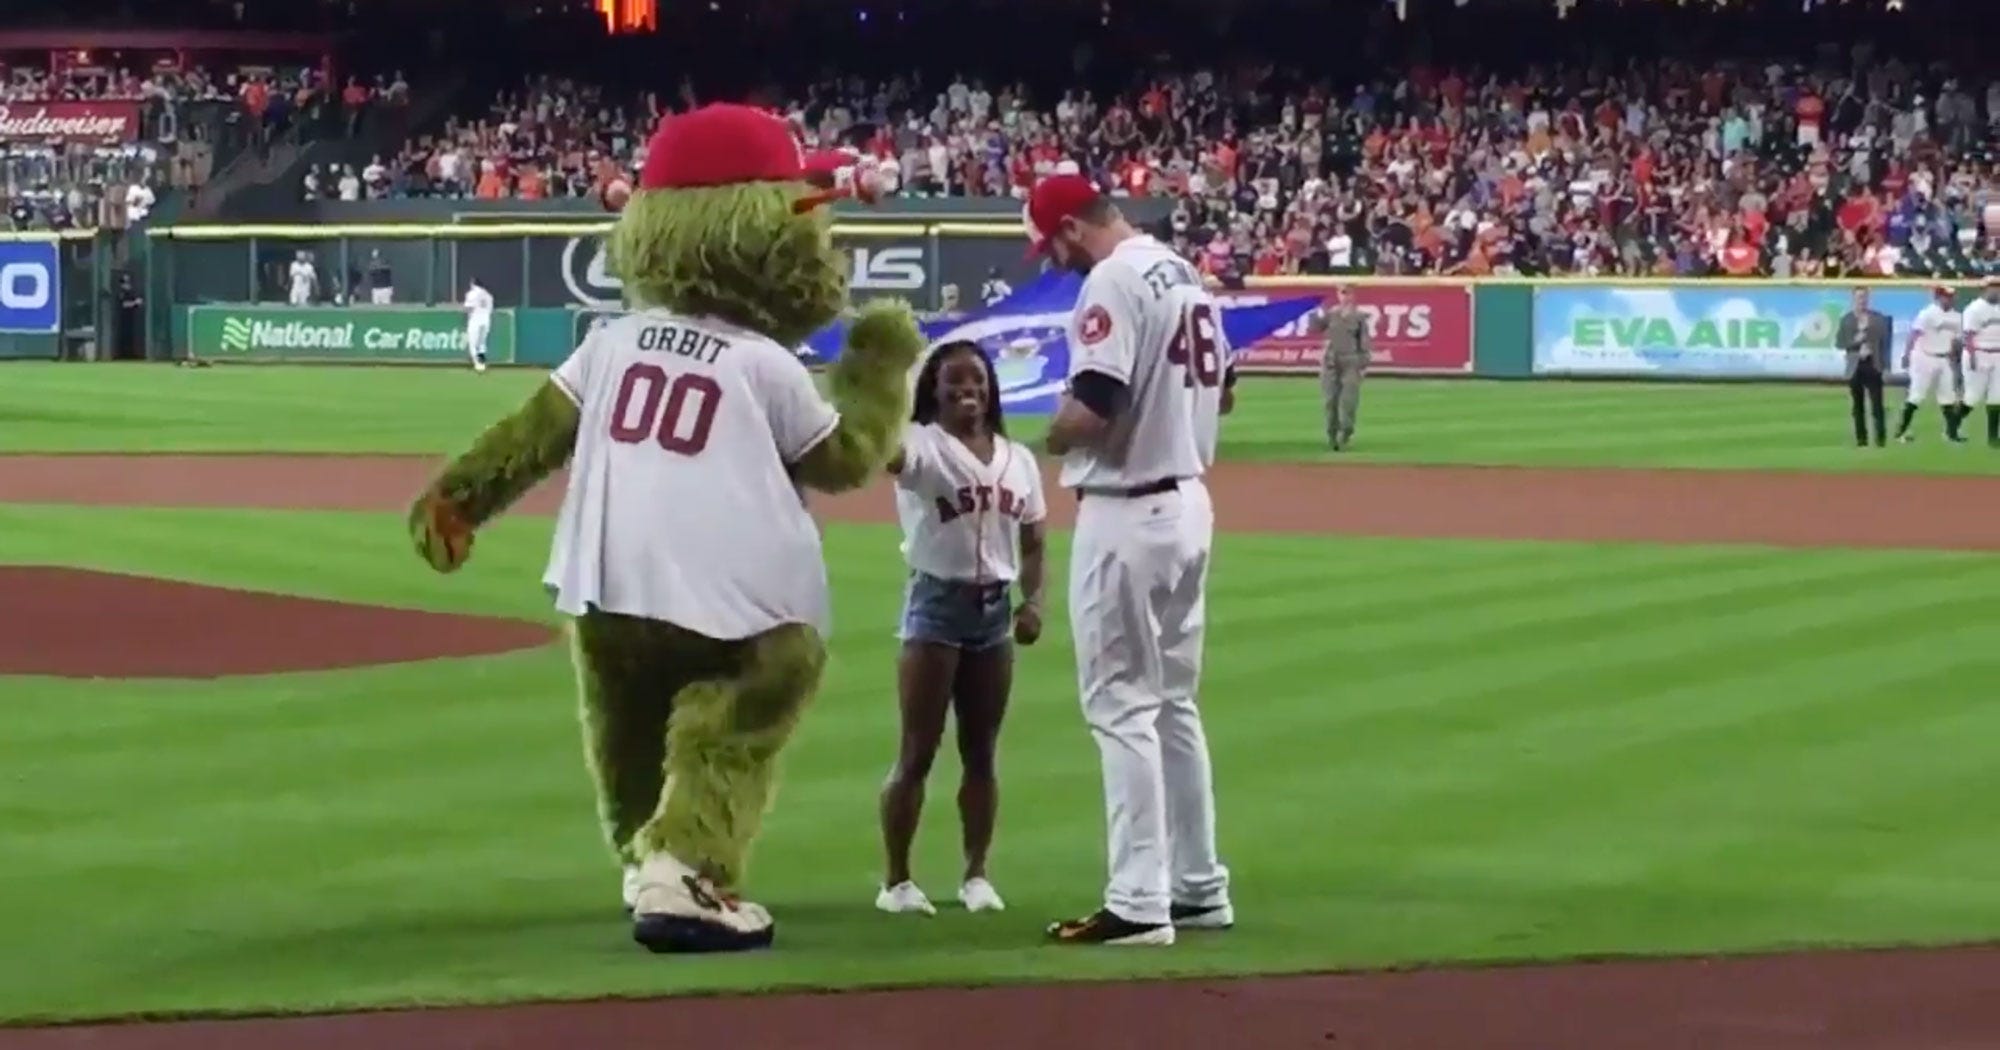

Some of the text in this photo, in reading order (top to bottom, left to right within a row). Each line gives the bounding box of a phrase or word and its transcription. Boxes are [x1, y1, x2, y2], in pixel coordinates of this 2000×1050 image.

[364, 328, 402, 349] Car
[405, 328, 468, 349] Renta
[1273, 304, 1431, 338] RTS
[1573, 317, 1780, 348] EVA AIR
[637, 326, 731, 364] ORBIT
[1167, 303, 1219, 388] 46
[610, 361, 723, 457] 00
